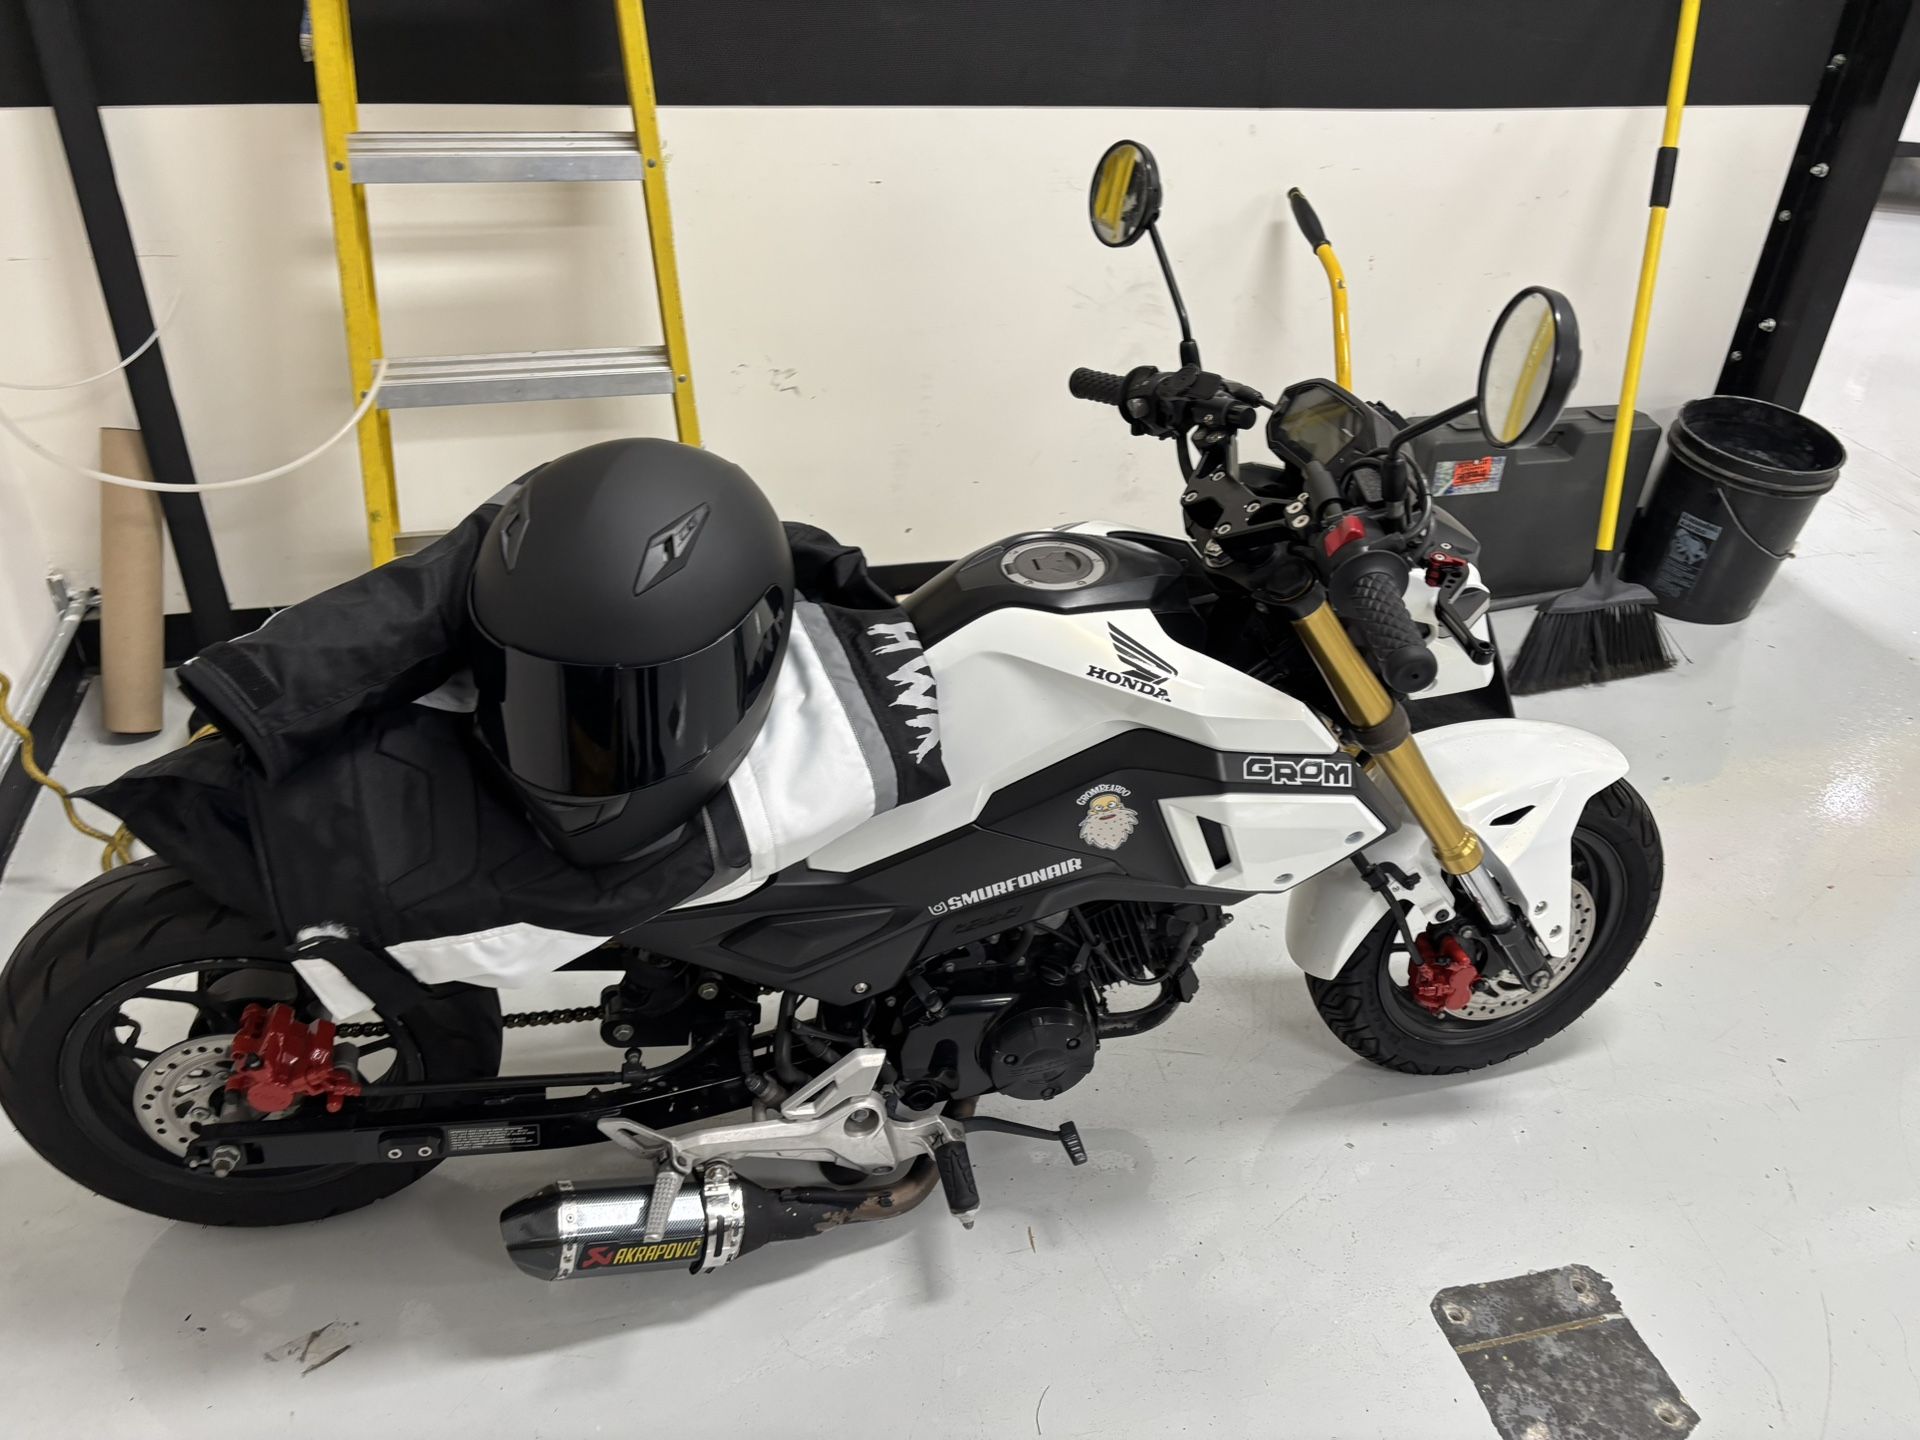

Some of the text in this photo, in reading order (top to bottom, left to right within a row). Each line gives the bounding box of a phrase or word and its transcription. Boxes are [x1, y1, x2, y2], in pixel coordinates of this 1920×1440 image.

[1086, 665, 1171, 702] HONDA
[1243, 756, 1352, 787] GROM
[947, 857, 1083, 910] SMURFONAIR
